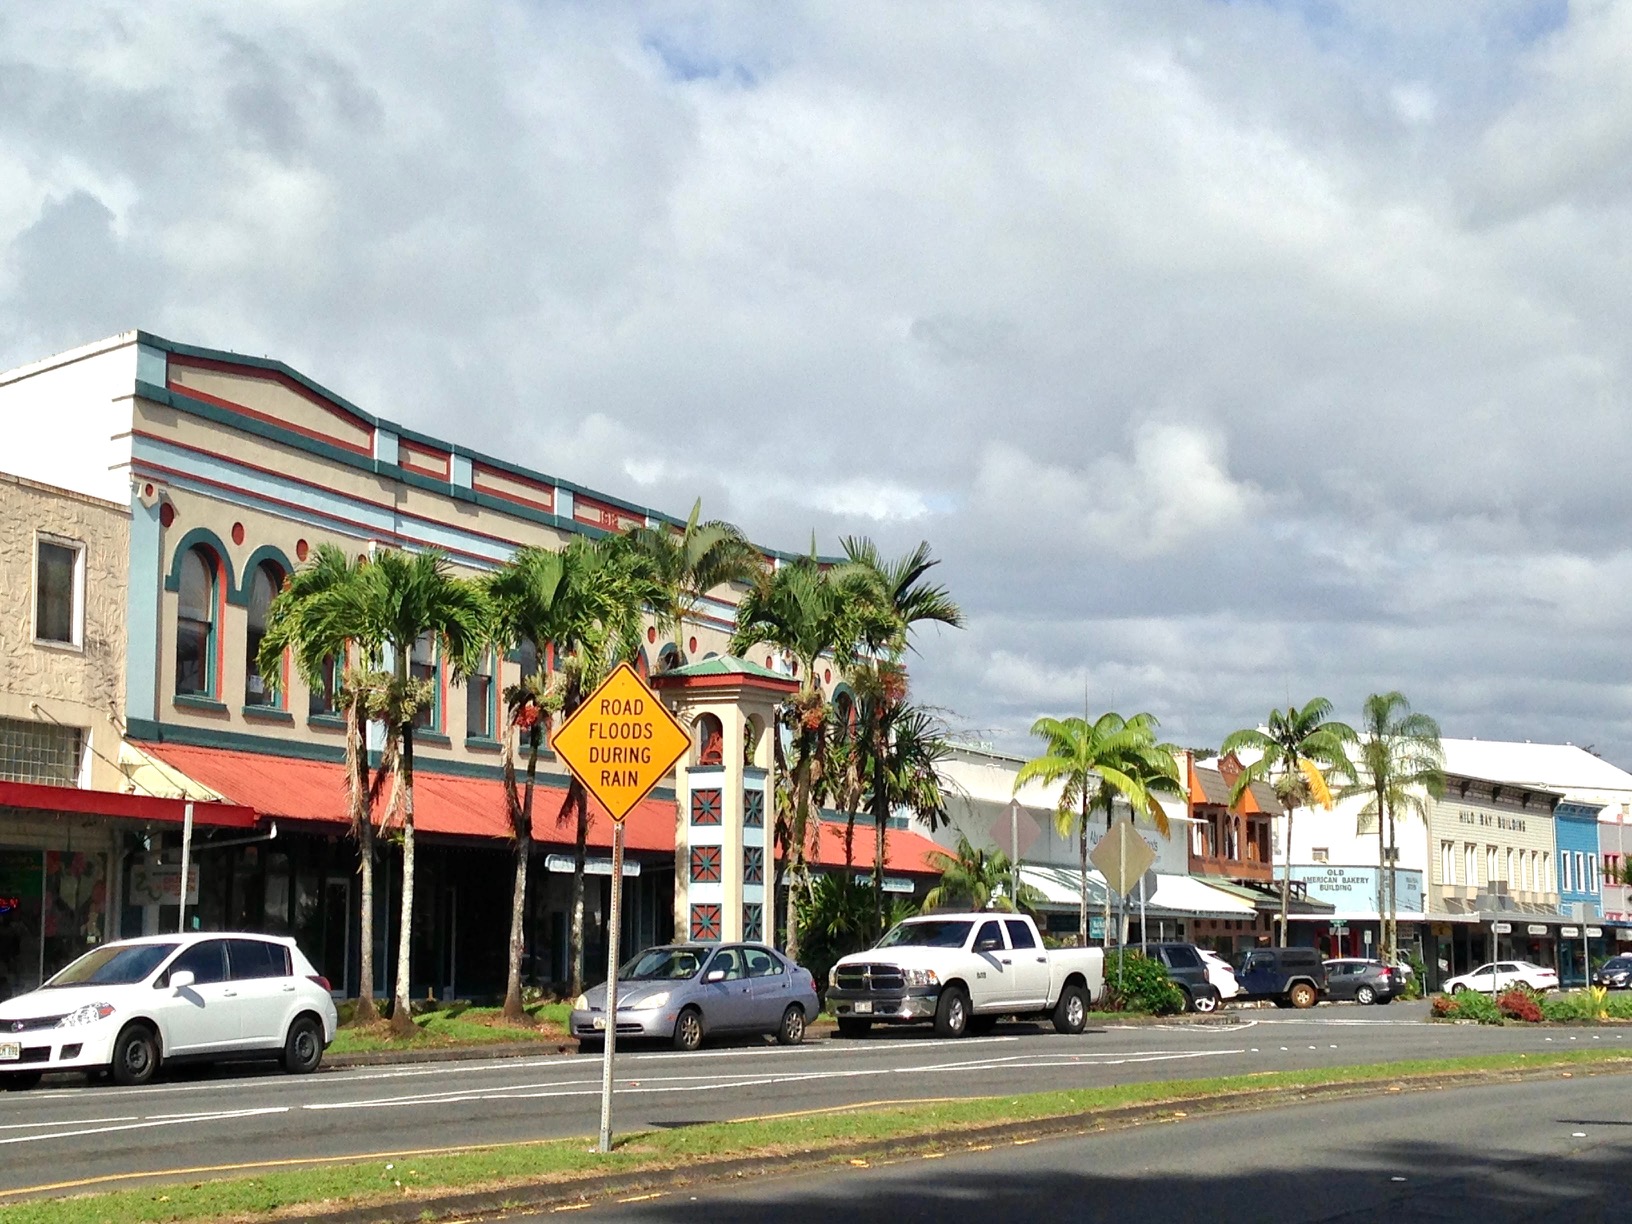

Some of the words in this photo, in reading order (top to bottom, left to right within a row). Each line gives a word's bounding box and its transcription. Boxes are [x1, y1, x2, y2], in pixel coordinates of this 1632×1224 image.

[600, 699, 644, 716] ROAD
[589, 722, 653, 740] FLOODS
[589, 746, 651, 764] DURING
[600, 770, 638, 787] RAIN
[1459, 810, 1474, 824] HILO
[1480, 813, 1492, 827] BAY
[1497, 816, 1526, 832] BUILDING
[1302, 876, 1338, 884] AMERICAN
[1342, 876, 1370, 884] BAKERY
